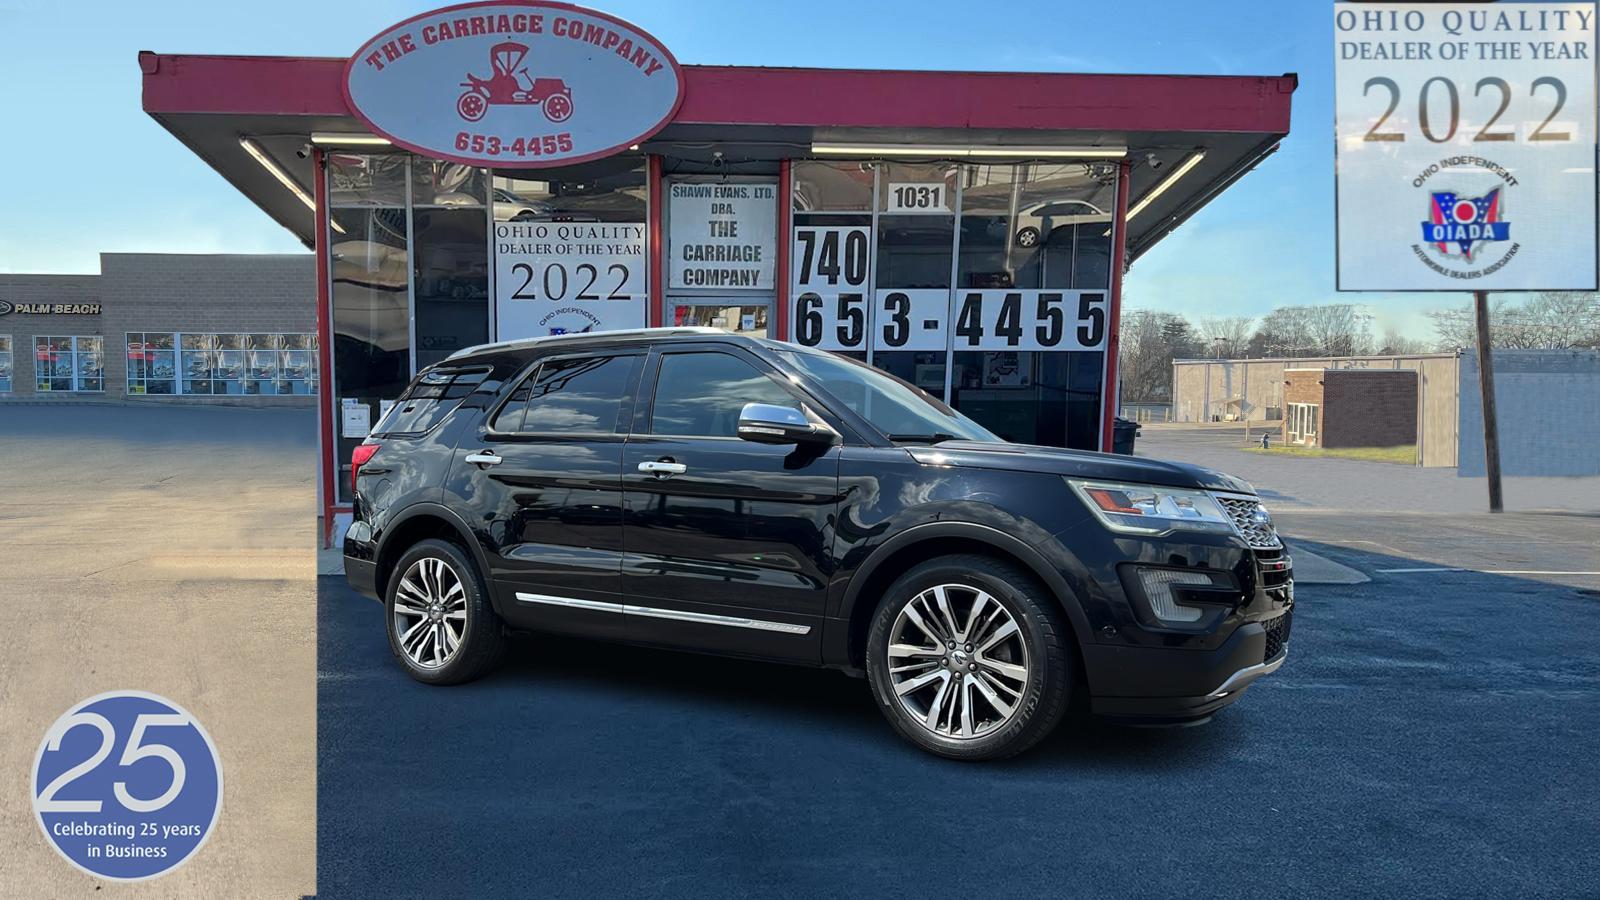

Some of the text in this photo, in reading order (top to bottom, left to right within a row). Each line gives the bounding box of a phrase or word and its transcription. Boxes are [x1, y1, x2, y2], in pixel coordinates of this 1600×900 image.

[1336, 10, 1592, 35] OHIO QUALITY
[365, 14, 664, 77] THE CARRIAGE COMPANY
[1340, 41, 1589, 60] DEALER OF THE YEAR
[1362, 76, 1571, 143] 2022
[455, 132, 573, 157] 653-4455
[1412, 155, 1519, 188] OHIO INDEPENDENT
[672, 186, 712, 199] SHAWN
[754, 186, 774, 199] LTD.
[894, 186, 941, 209] 1031
[711, 203, 736, 215] DBA.
[497, 225, 645, 241] OHIO QUALITY
[708, 220, 738, 237] THE
[1433, 224, 1495, 240] OIADA
[499, 243, 641, 255] DEALER OF THE YEAR
[683, 244, 762, 262] CARRIAGE
[797, 230, 868, 287] 740
[1411, 242, 1521, 280] AUTOMOBILE DEALERS ASSOCIATION
[510, 262, 632, 301] 2022
[683, 268, 761, 286] COMPANY
[15, 304, 100, 314] PALM BEACH
[555, 307, 601, 326] INDEPENDENT
